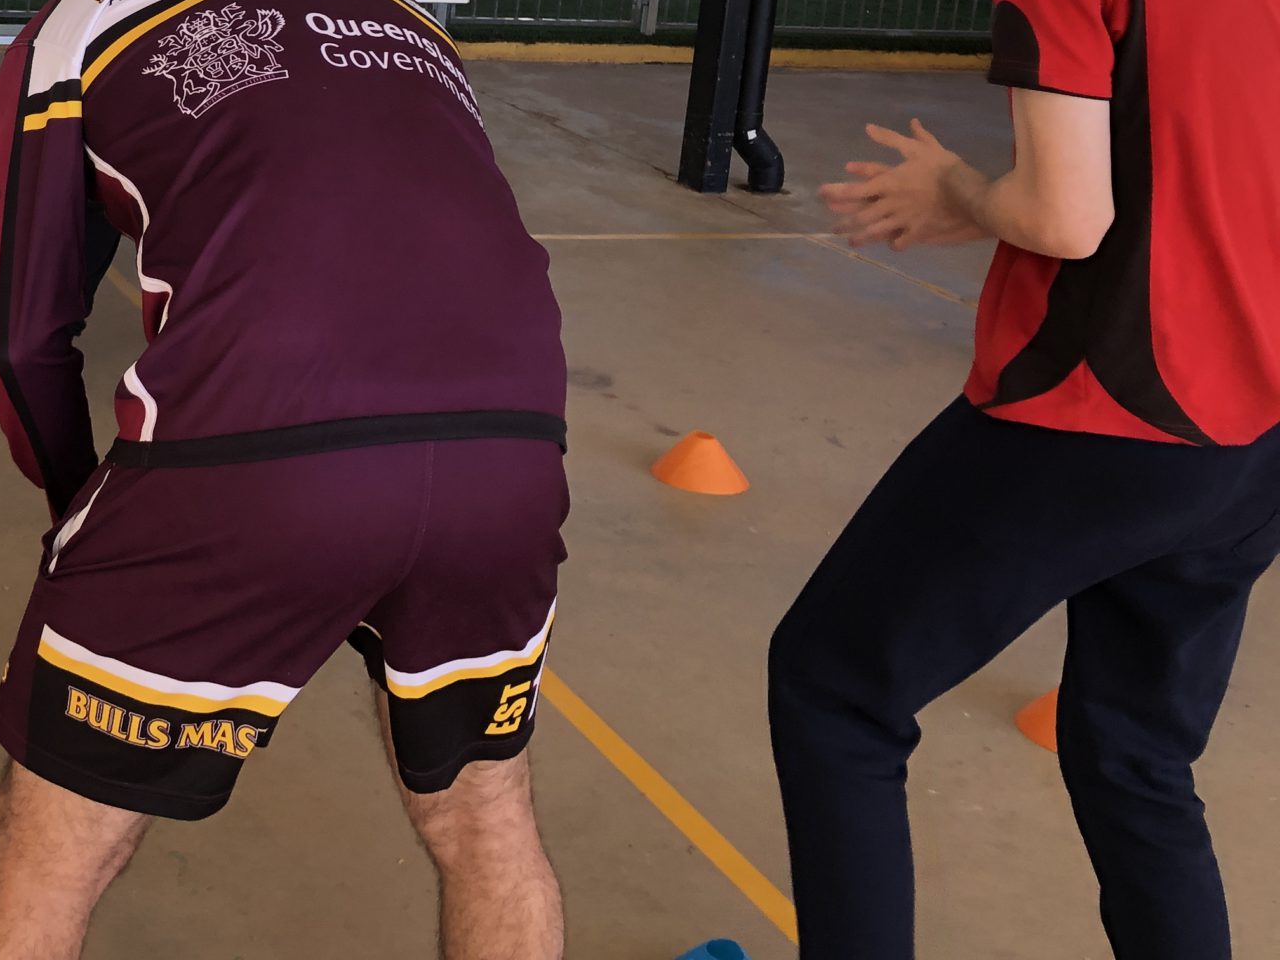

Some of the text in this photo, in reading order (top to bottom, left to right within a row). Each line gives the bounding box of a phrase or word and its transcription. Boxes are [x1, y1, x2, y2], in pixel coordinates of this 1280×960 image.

[65, 685, 268, 759] BULLS MAS
[484, 680, 531, 735] EST
